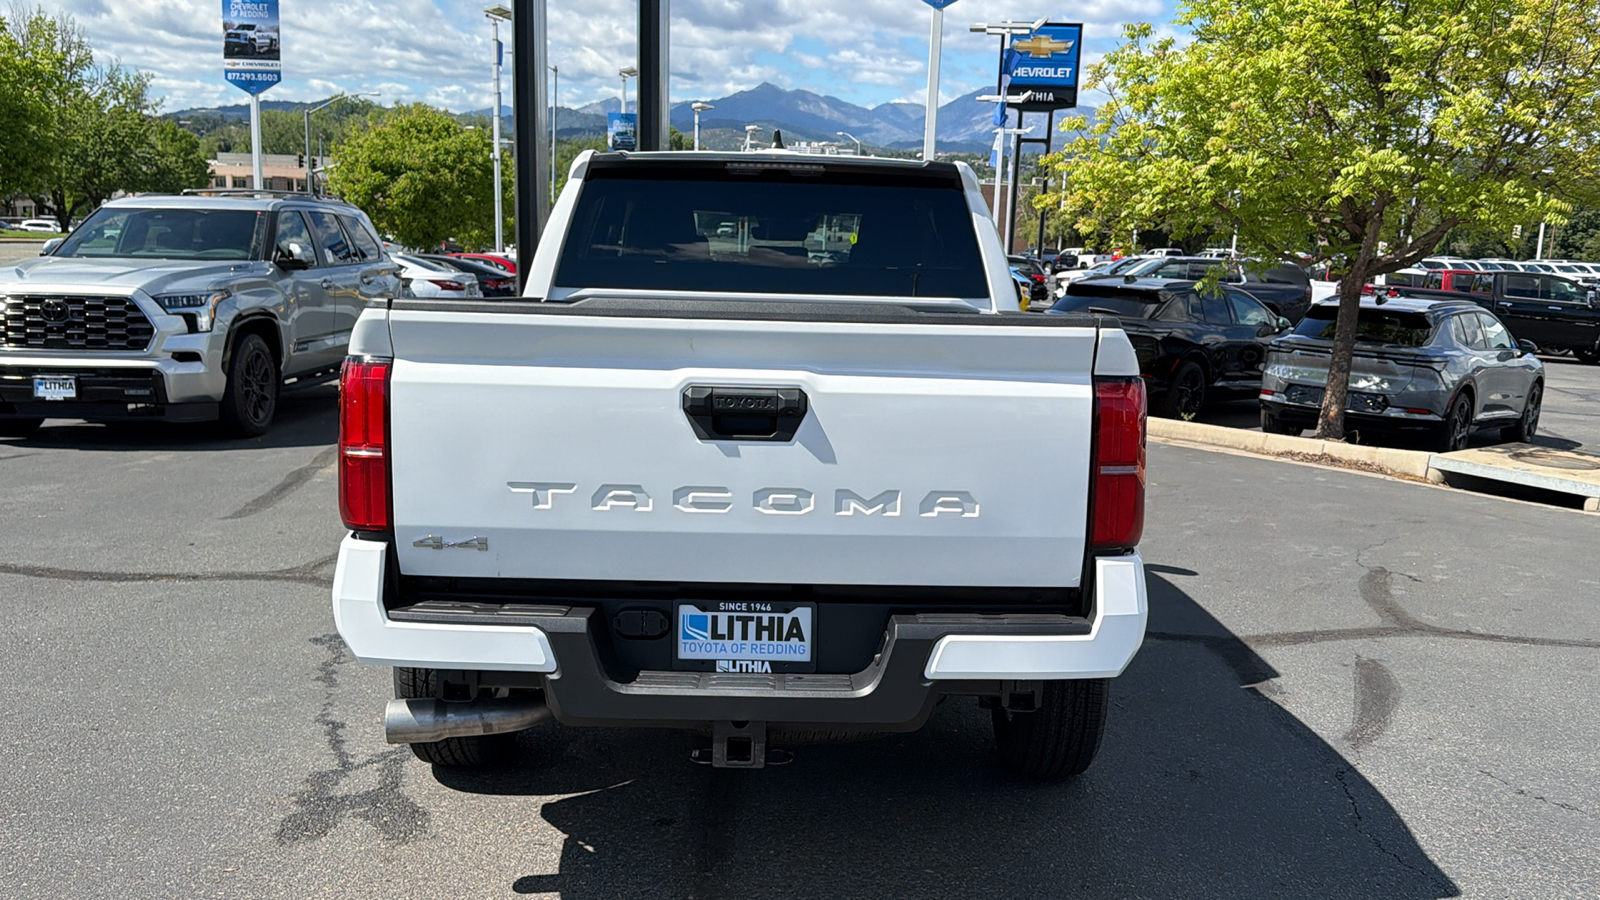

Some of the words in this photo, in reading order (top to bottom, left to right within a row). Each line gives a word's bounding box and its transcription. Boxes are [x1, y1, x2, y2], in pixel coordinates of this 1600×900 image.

[230, 3, 268, 11] CHEVROLET
[240, 10, 268, 18] REDDING
[227, 72, 278, 81] 877.293.5503
[1012, 67, 1072, 78] HEVROLET
[1020, 91, 1054, 102] THIA
[44, 381, 74, 390] LITHIA
[715, 397, 774, 409] TOYOTA
[507, 481, 981, 519] TACOMA
[719, 602, 747, 611] SINCE
[750, 603, 772, 612] 1946
[711, 615, 805, 642] LITHIA
[682, 642, 727, 653] TOYOTA
[730, 642, 747, 653] OF
[750, 643, 806, 655] REDDING
[728, 661, 772, 673] LITHIA
